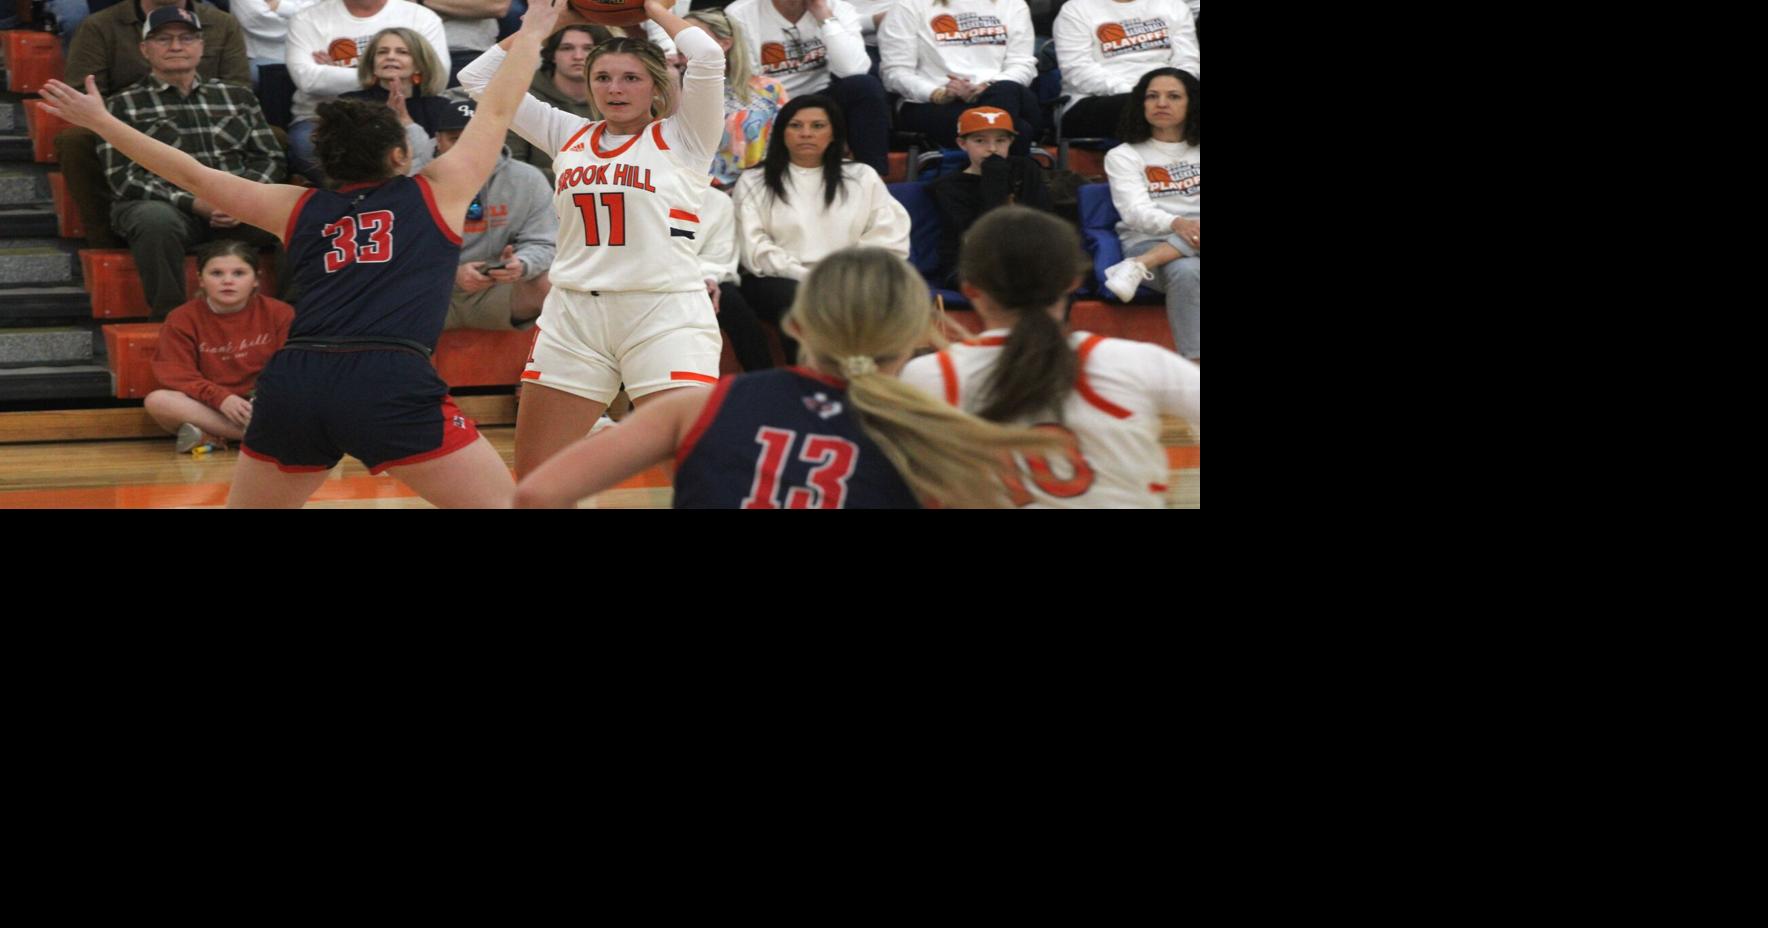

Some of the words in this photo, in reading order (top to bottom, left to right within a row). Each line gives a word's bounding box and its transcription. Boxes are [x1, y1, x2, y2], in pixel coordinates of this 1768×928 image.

[935, 26, 1006, 41] PLAYOFFS
[760, 47, 826, 75] PLAYFFS
[613, 163, 656, 193] HILL
[572, 192, 626, 246] 11
[321, 210, 394, 273] 33
[740, 426, 860, 509] 13
